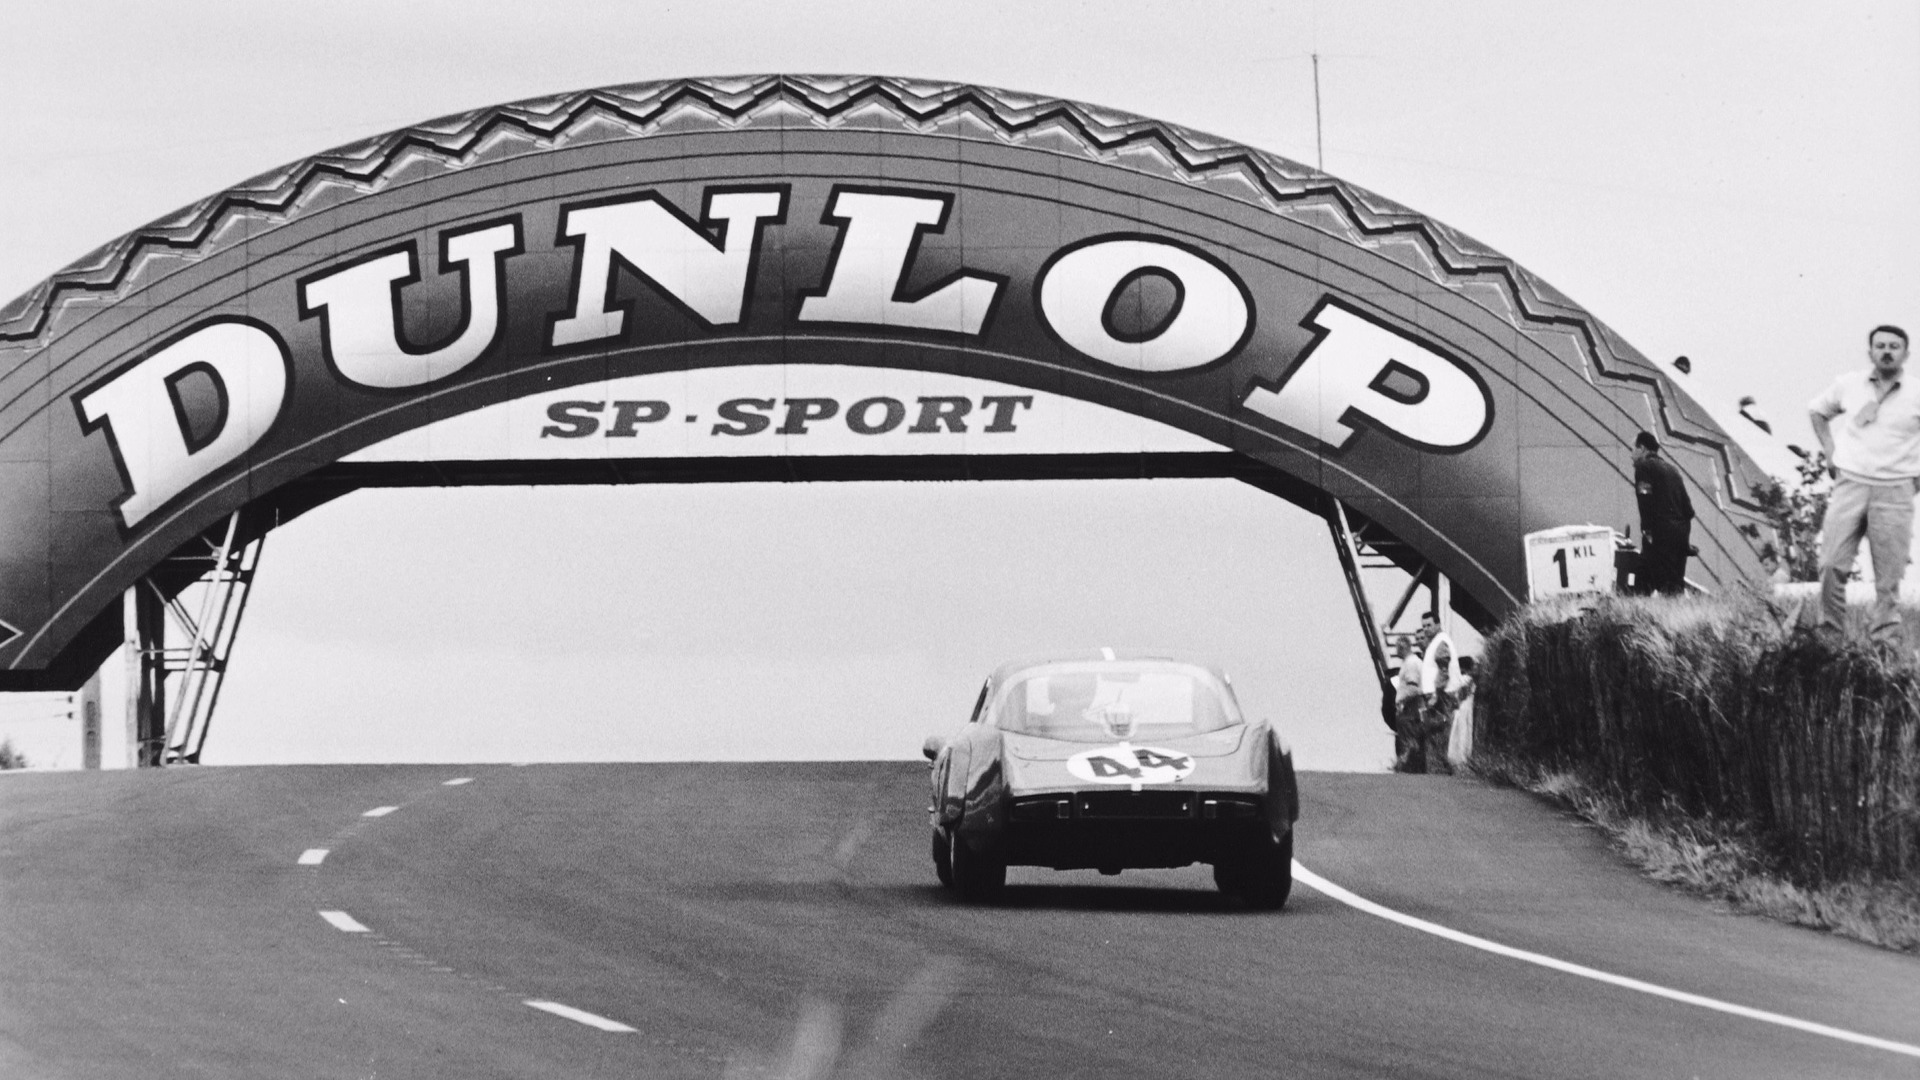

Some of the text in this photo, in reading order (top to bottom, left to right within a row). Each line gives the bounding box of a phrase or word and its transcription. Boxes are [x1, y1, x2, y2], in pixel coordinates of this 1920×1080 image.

[73, 184, 1494, 533] DUNLOP
[1553, 548, 1569, 588] 1
[1573, 545, 1596, 558] KIL
[1086, 749, 1189, 778] 44
